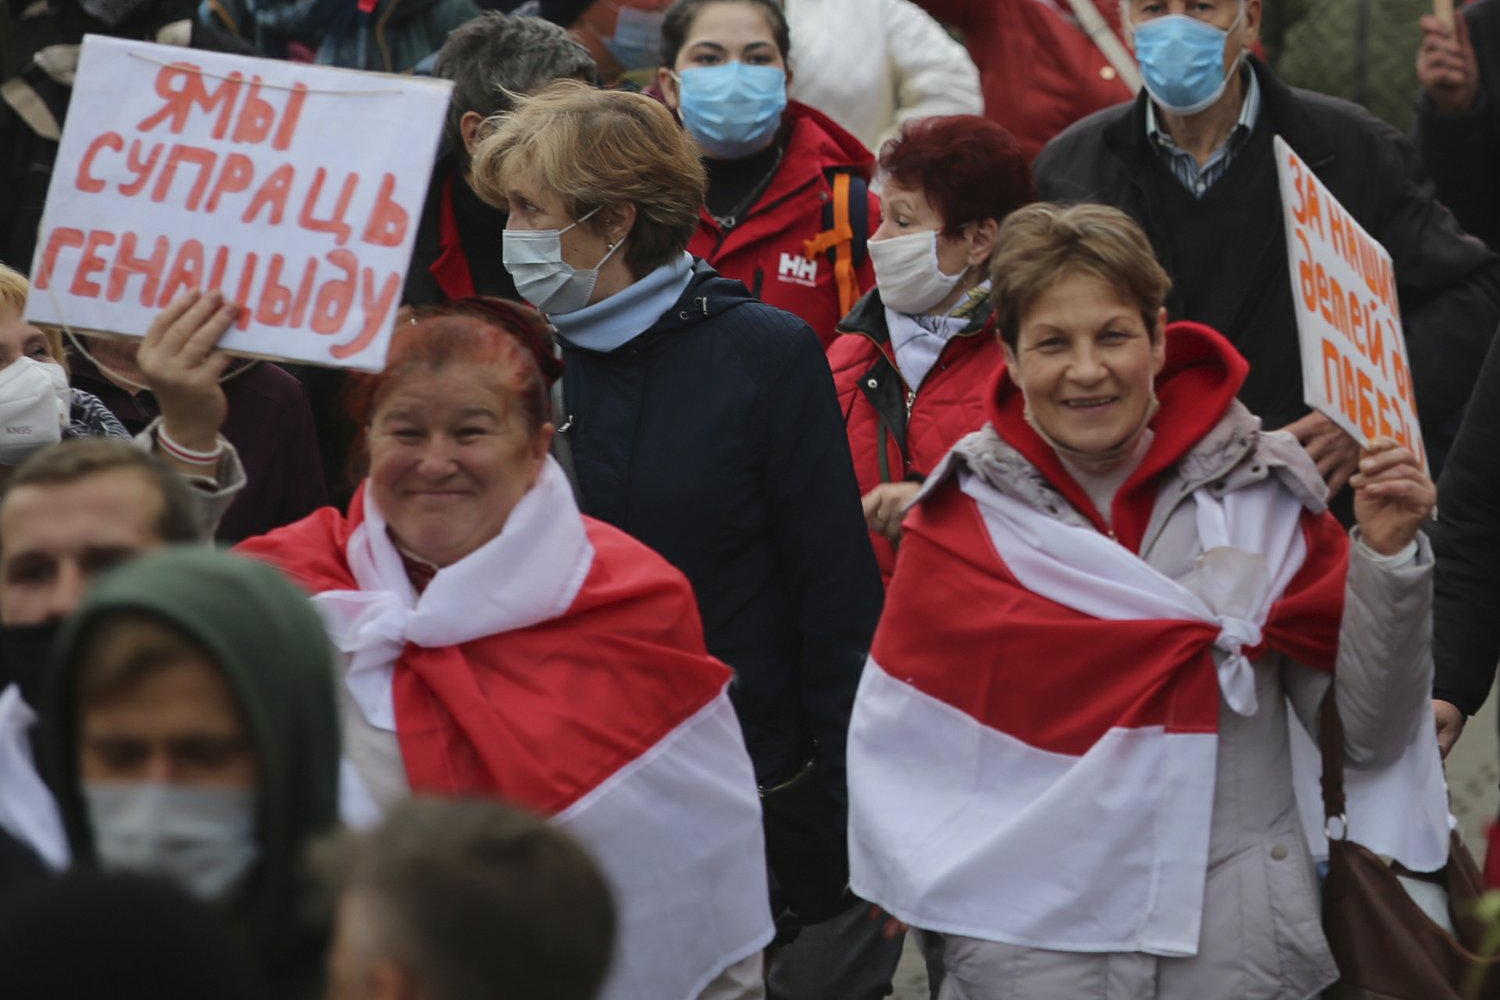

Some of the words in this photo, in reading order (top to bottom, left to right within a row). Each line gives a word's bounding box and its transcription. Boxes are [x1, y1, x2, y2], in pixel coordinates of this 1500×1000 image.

[75, 131, 409, 248] СУПРАЦЬ
[1289, 152, 1325, 243] ЗА
[779, 252, 817, 281] HH
